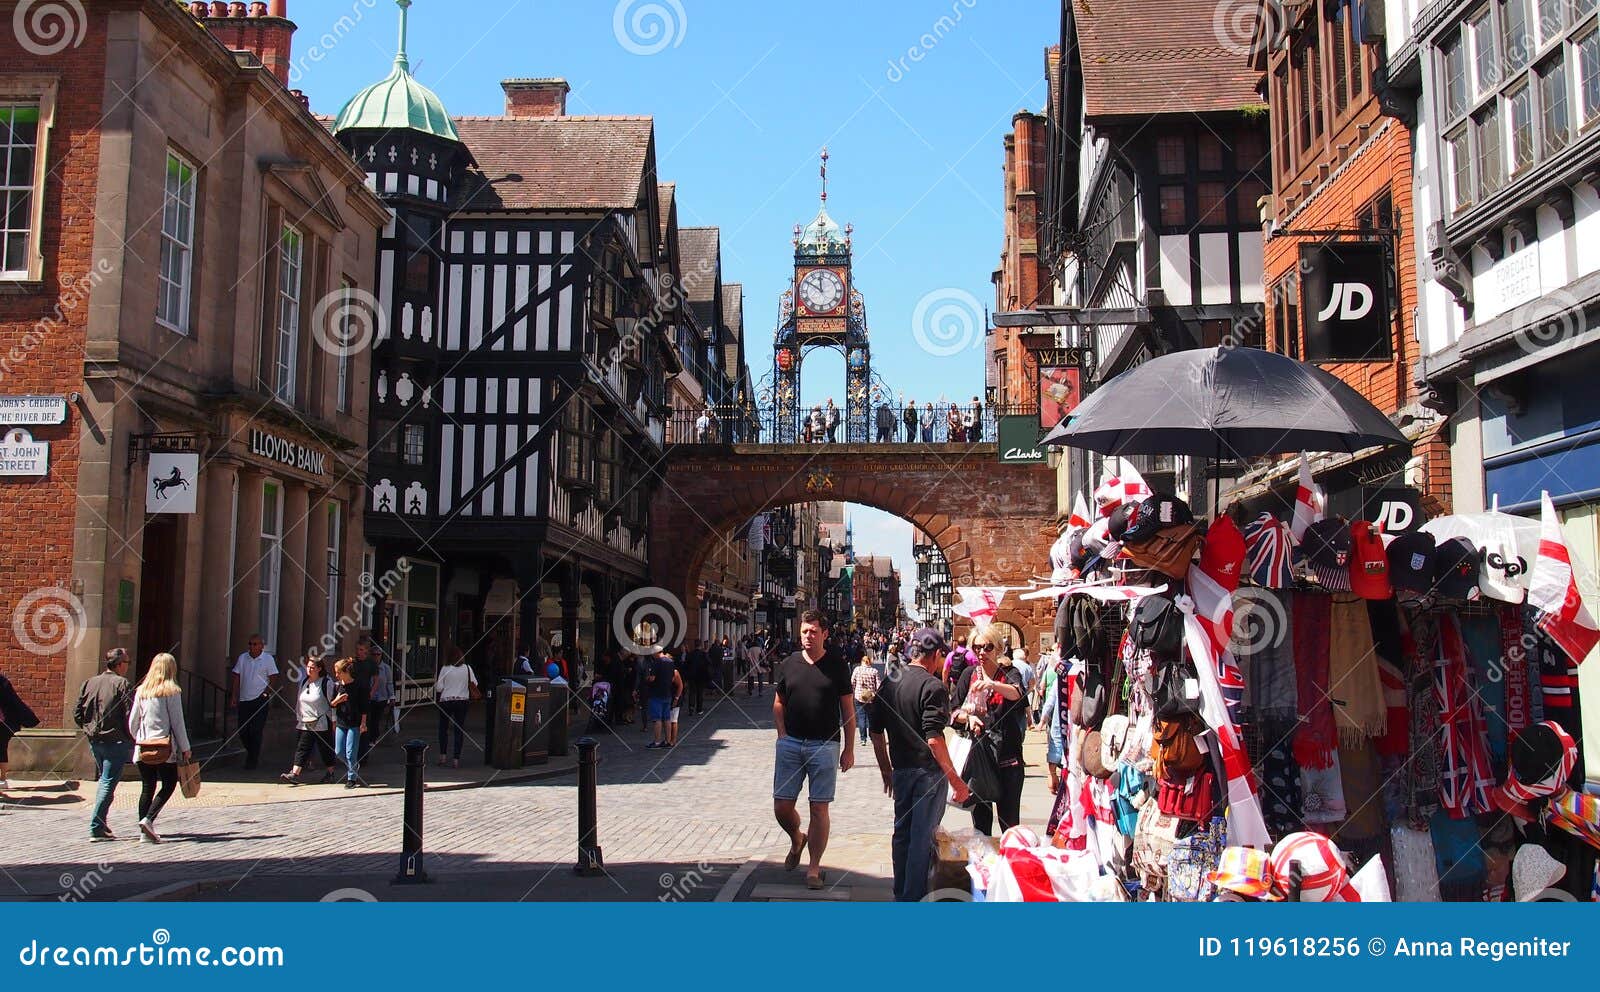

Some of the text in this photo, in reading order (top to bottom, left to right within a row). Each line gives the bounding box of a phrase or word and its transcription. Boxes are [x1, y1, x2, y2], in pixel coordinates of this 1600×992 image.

[1318, 283, 1373, 321] JD
[797, 305, 807, 316] 18
[1040, 350, 1079, 365] WHS
[29, 399, 60, 408] CHURCH
[0, 413, 12, 421] HE
[15, 413, 38, 421] RIVER
[12, 448, 40, 457] JOHN
[253, 428, 325, 475] LLOYDS BANK
[1004, 448, 1042, 459] Clarks
[1372, 501, 1413, 531] JD
